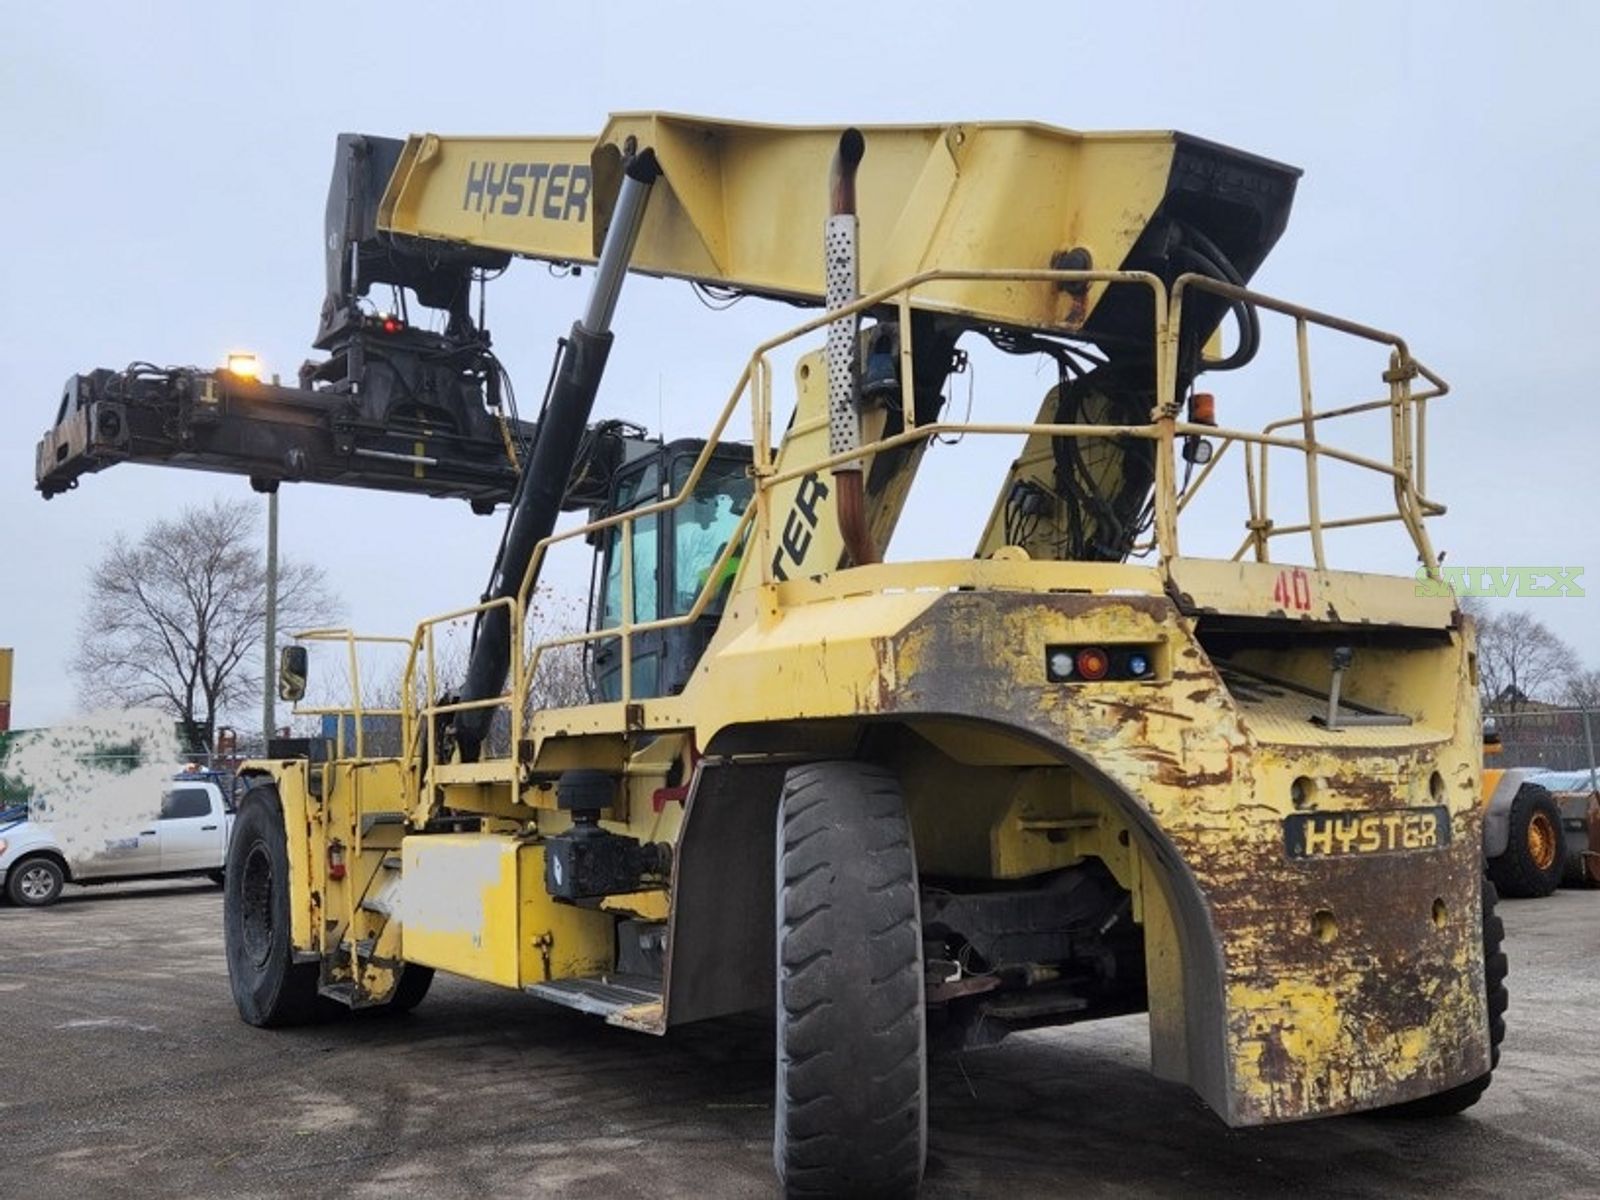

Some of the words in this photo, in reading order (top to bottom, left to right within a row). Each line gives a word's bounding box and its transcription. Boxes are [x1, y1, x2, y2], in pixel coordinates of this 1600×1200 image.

[464, 161, 592, 222] HYSTER
[1274, 567, 1311, 610] 40
[1305, 813, 1437, 855] HYSTER
